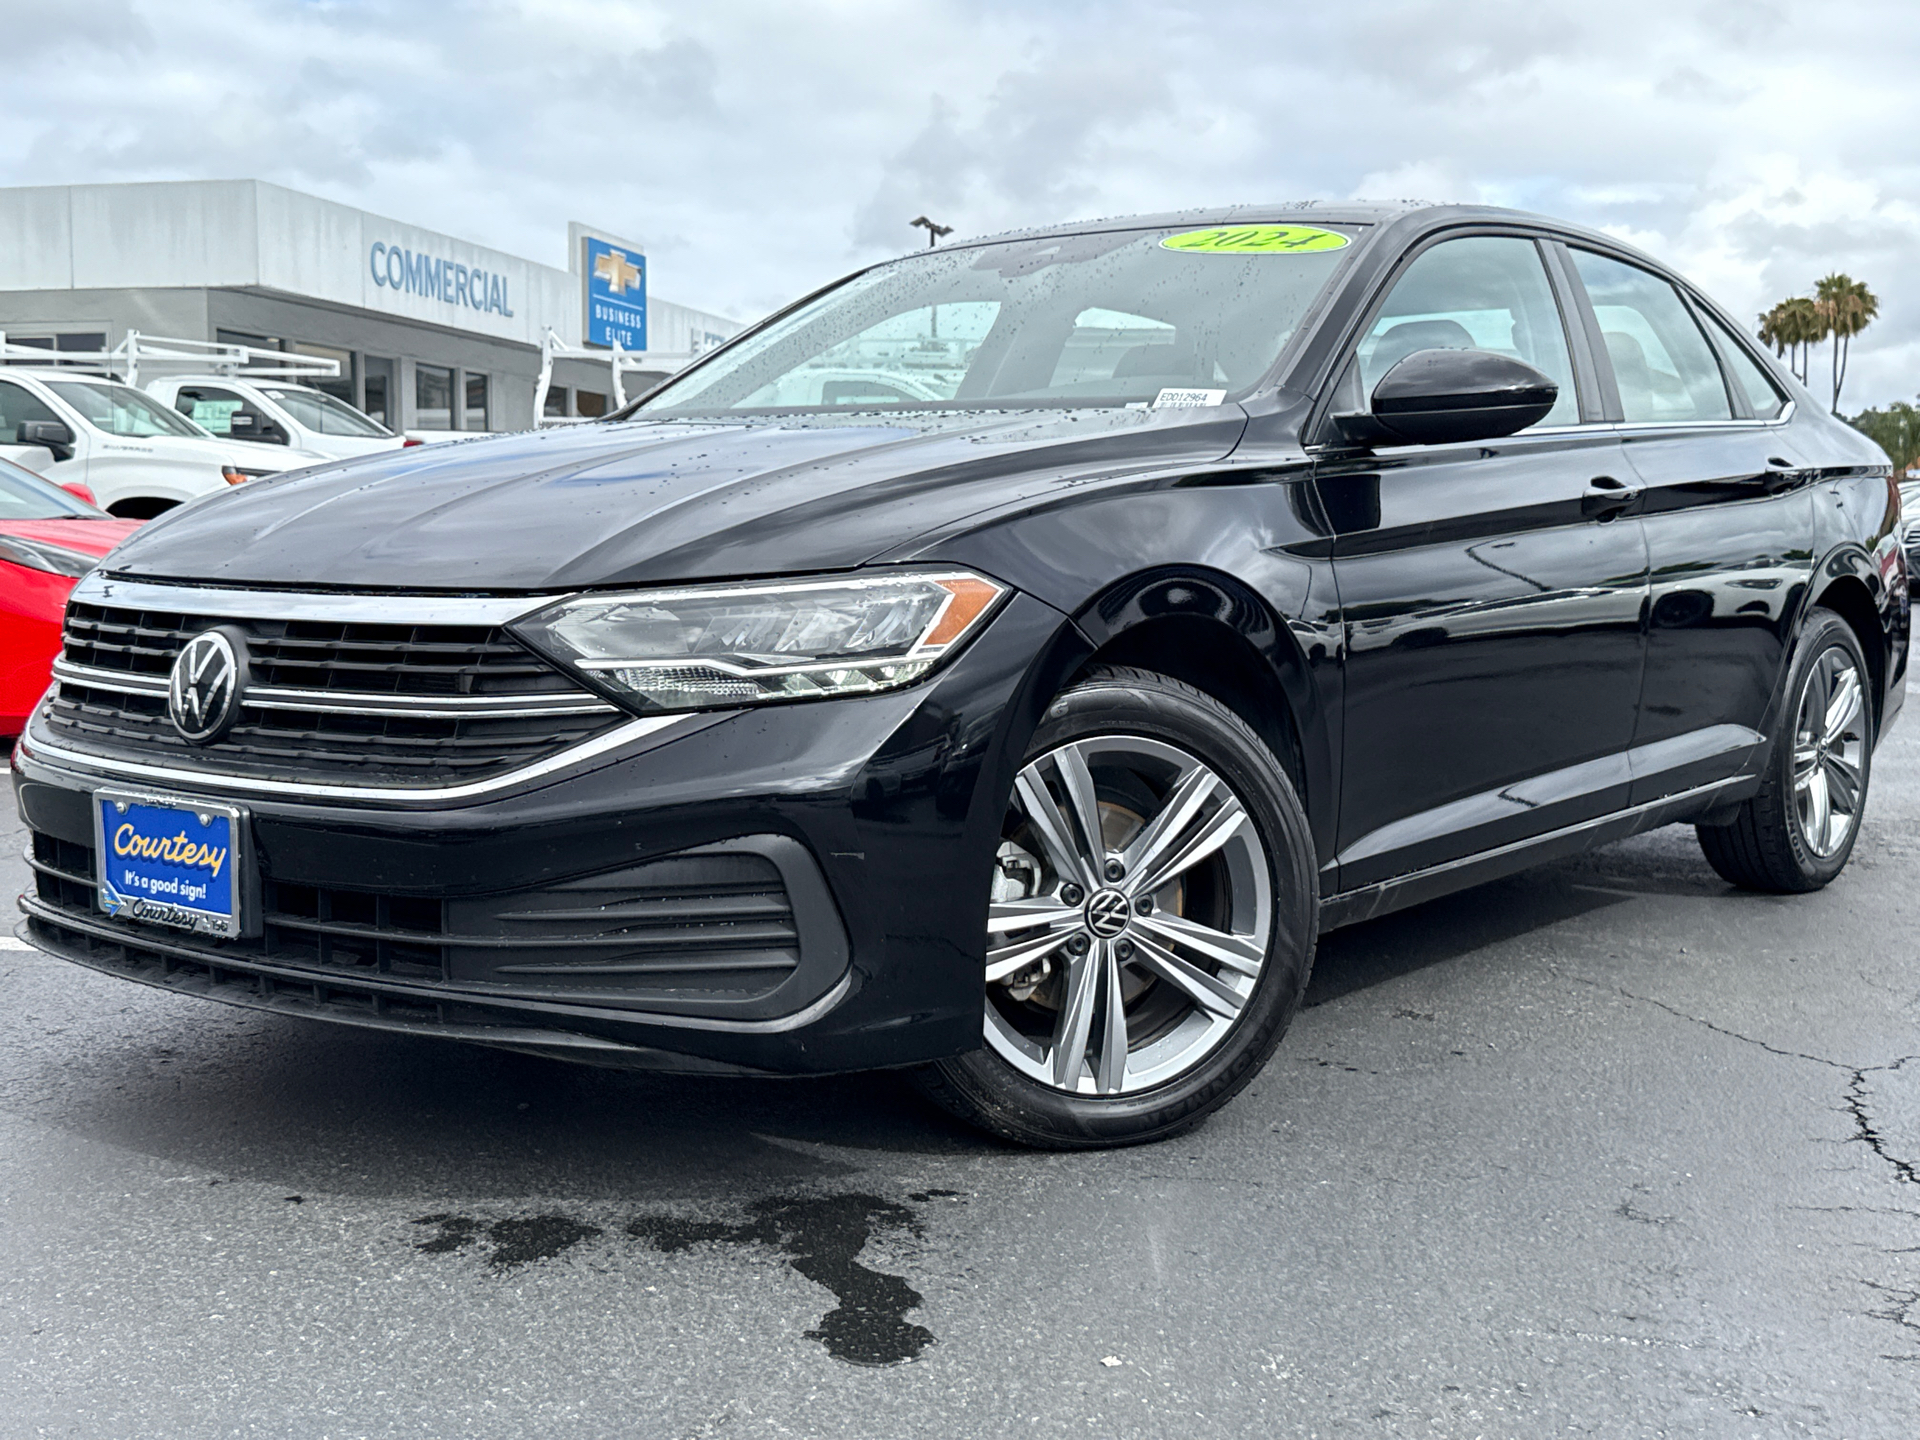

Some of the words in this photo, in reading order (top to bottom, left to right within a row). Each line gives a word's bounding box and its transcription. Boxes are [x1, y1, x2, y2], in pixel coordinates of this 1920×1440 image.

[1180, 230, 1328, 249] 2024
[370, 241, 514, 318] COMMERCIAL
[595, 304, 642, 329] BUSINESS
[605, 326, 633, 346] ELITE
[114, 823, 227, 877] Courtesy
[125, 869, 140, 886] It's
[141, 877, 149, 888] a
[150, 877, 179, 894] good
[179, 880, 207, 901] sign!
[132, 898, 199, 931] Courtesy
